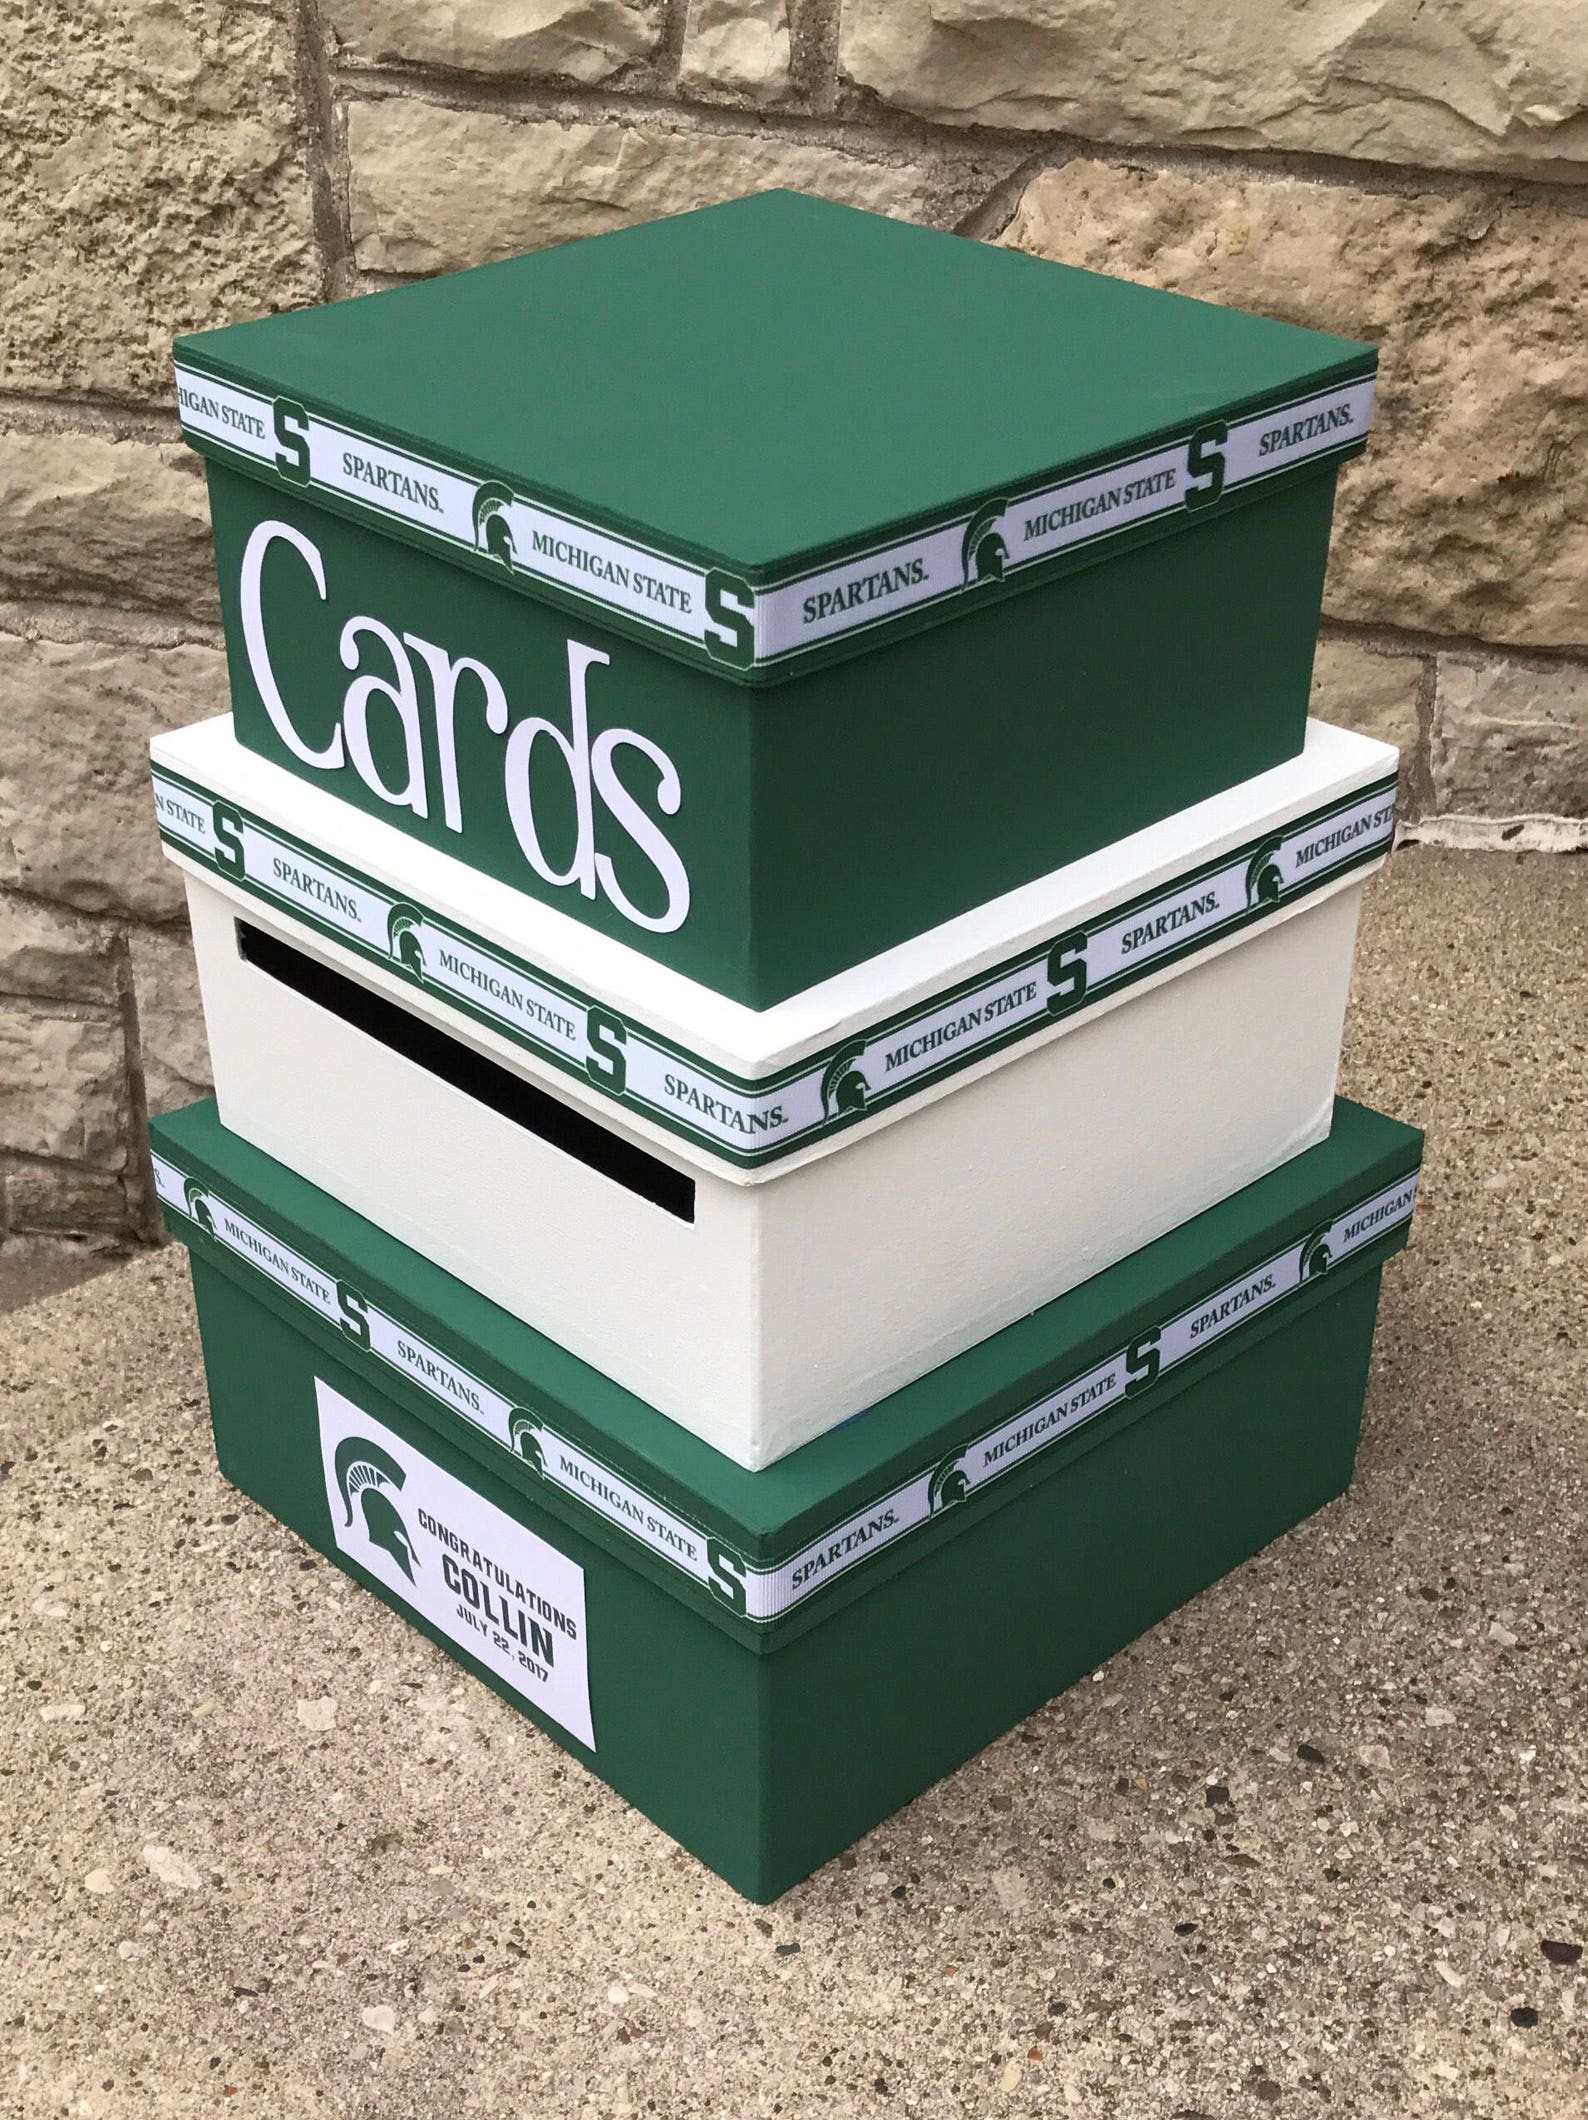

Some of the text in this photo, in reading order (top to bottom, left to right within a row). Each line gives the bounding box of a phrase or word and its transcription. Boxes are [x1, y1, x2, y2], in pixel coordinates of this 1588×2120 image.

[221, 405, 266, 439] STATE
[272, 396, 311, 488] S
[1024, 468, 1177, 541] MICHIGAN STATE
[1184, 420, 1228, 513] S
[532, 531, 692, 614] MICHIGAN STATE
[704, 567, 755, 671] S
[240, 520, 690, 933] Cards
[166, 799, 206, 834] STATE
[212, 800, 246, 882] S
[1295, 817, 1371, 868] MICHIGAN
[439, 949, 576, 1041] MICHIGAN STATE
[1046, 930, 1088, 1017] S
[586, 1005, 628, 1097] S
[885, 982, 1037, 1072] MICHIGAN STATE
[224, 1218, 331, 1304] MICHIGAN STATE
[1343, 1193, 1413, 1243] MICHIGAN
[336, 1280, 371, 1353] S
[1124, 1325, 1161, 1399] S
[983, 1373, 1117, 1468] MICHIGAN STATE
[559, 1455, 698, 1562] MICHIGAN STATE
[417, 1507, 577, 1640] CONGRATULATIONS
[442, 1554, 554, 1667] COLLIN
[706, 1536, 747, 1618] S
[456, 1604, 549, 1683] JULY 22, 2017
